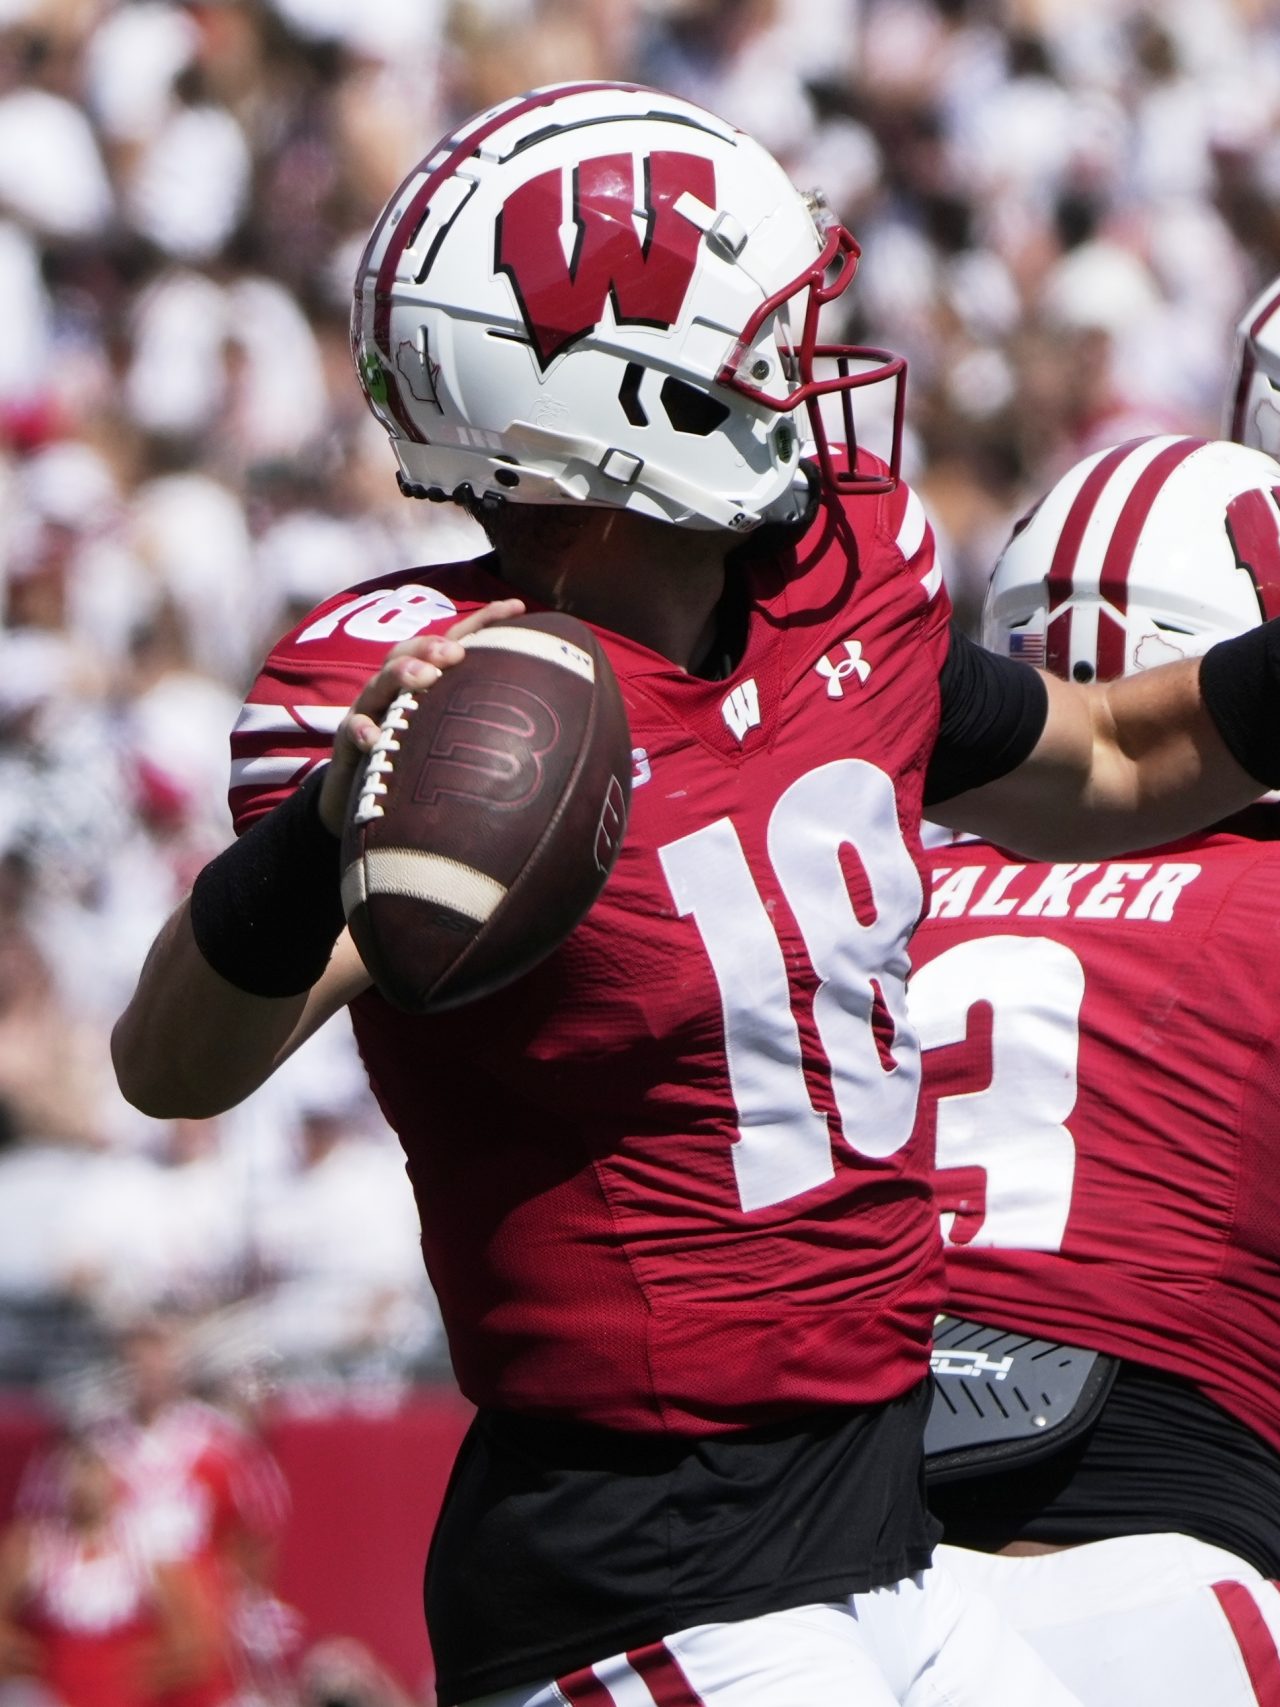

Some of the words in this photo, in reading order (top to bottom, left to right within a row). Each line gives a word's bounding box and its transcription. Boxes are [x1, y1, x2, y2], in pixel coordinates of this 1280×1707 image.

[493, 150, 717, 373] W
[295, 583, 458, 643] 18
[721, 677, 763, 743] W
[926, 862, 1202, 922] ALKER
[658, 758, 924, 1214] 18
[906, 934, 1086, 1252] 3
